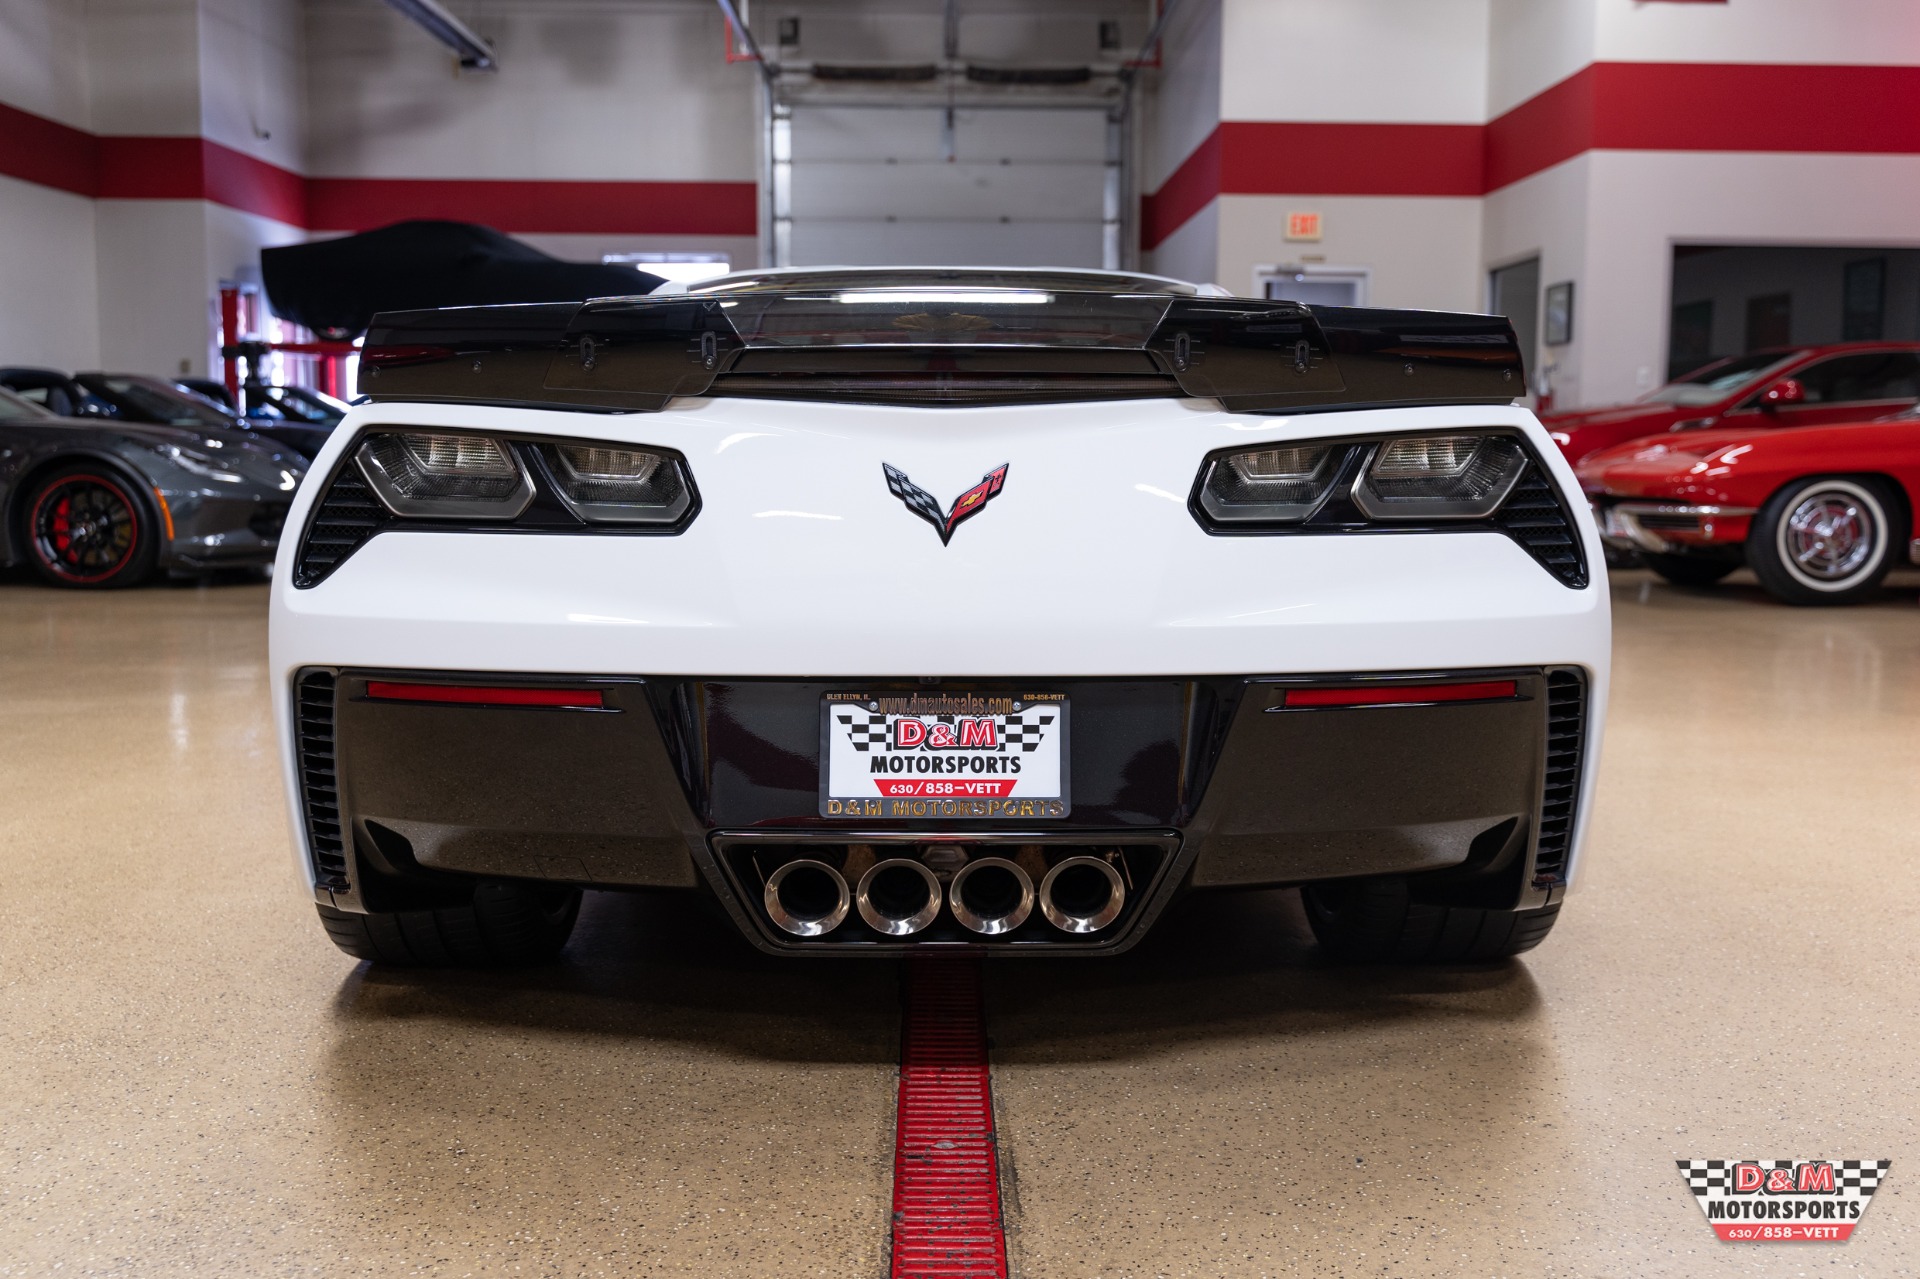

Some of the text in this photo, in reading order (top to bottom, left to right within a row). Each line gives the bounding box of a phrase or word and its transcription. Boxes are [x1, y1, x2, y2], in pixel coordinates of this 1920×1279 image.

[1290, 213, 1318, 236] EXIT
[879, 693, 1013, 715] www.dmautosales.com
[894, 719, 998, 749] D&M
[870, 755, 1021, 773] MOTORSPORTS
[892, 800, 1064, 816] MOTORSPORTS
